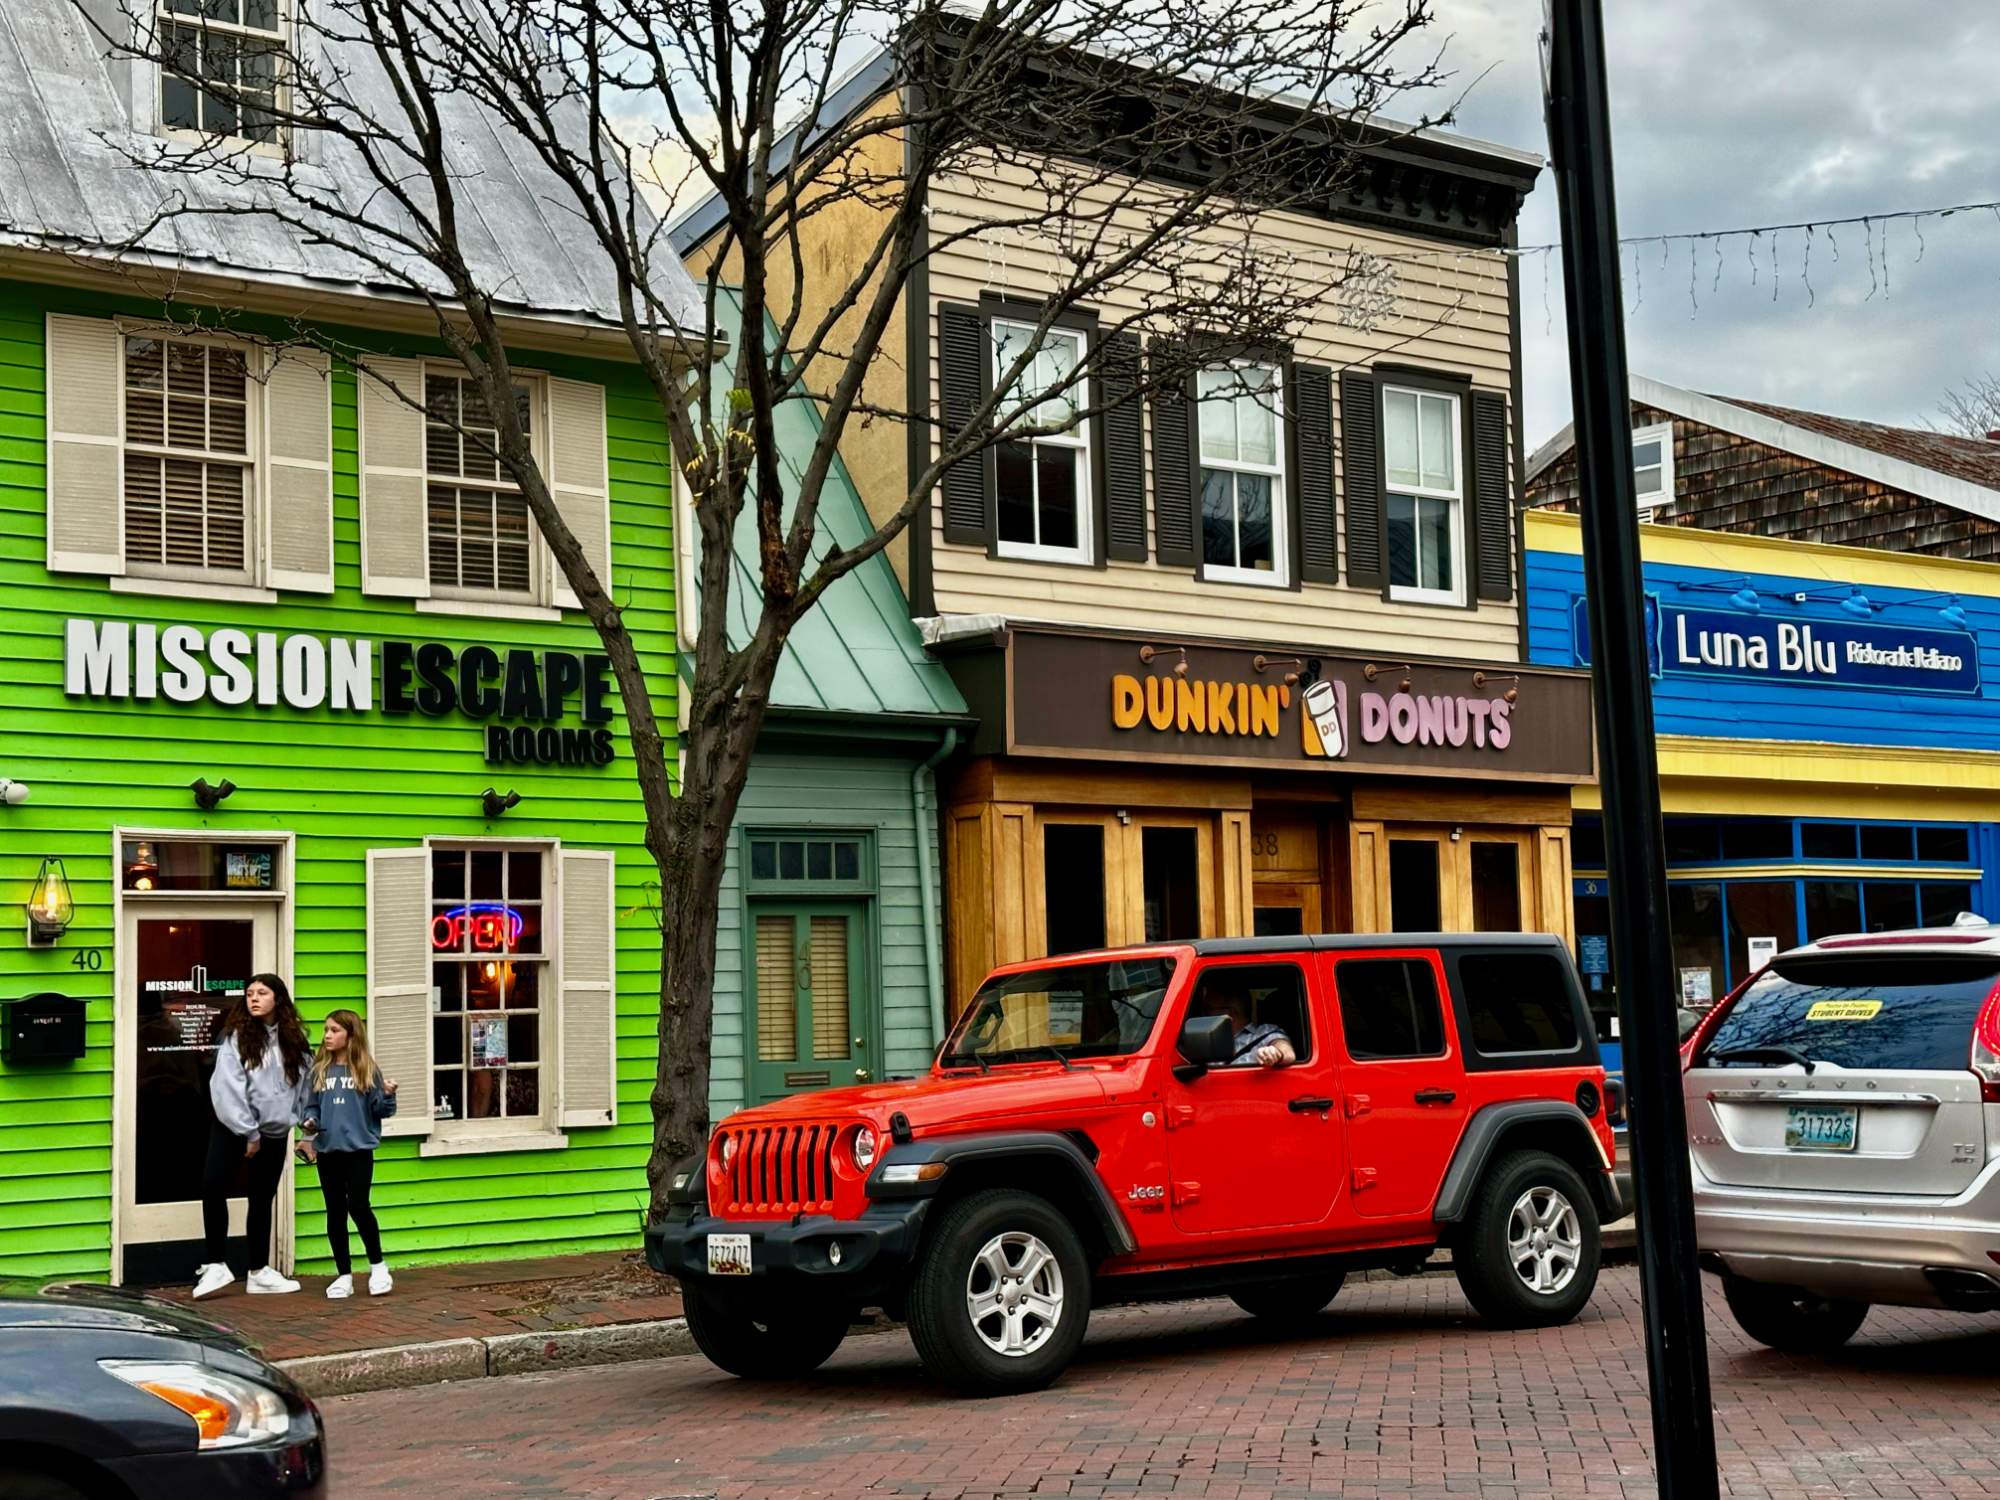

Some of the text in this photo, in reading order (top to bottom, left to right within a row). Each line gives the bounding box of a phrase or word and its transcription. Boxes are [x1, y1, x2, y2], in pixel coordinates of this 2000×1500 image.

[1677, 614, 1837, 674] Luna Blu
[64, 618, 615, 722] MISSION ESCAPE
[1111, 673, 1513, 750] DUNKIN' DONUTS
[1321, 722, 1337, 737] DD
[483, 725, 616, 769] ROOMS
[1251, 832, 1278, 857] 38
[261, 853, 271, 886] 2017
[1585, 880, 1598, 894] 36
[432, 915, 516, 948] OPEN
[72, 949, 102, 971] 40
[145, 980, 245, 992] MISSION ESCAPE
[1811, 1009, 1844, 1018] STUDENT
[1750, 1079, 1879, 1090] VOLVO
[1128, 1183, 1165, 1200] Jeep
